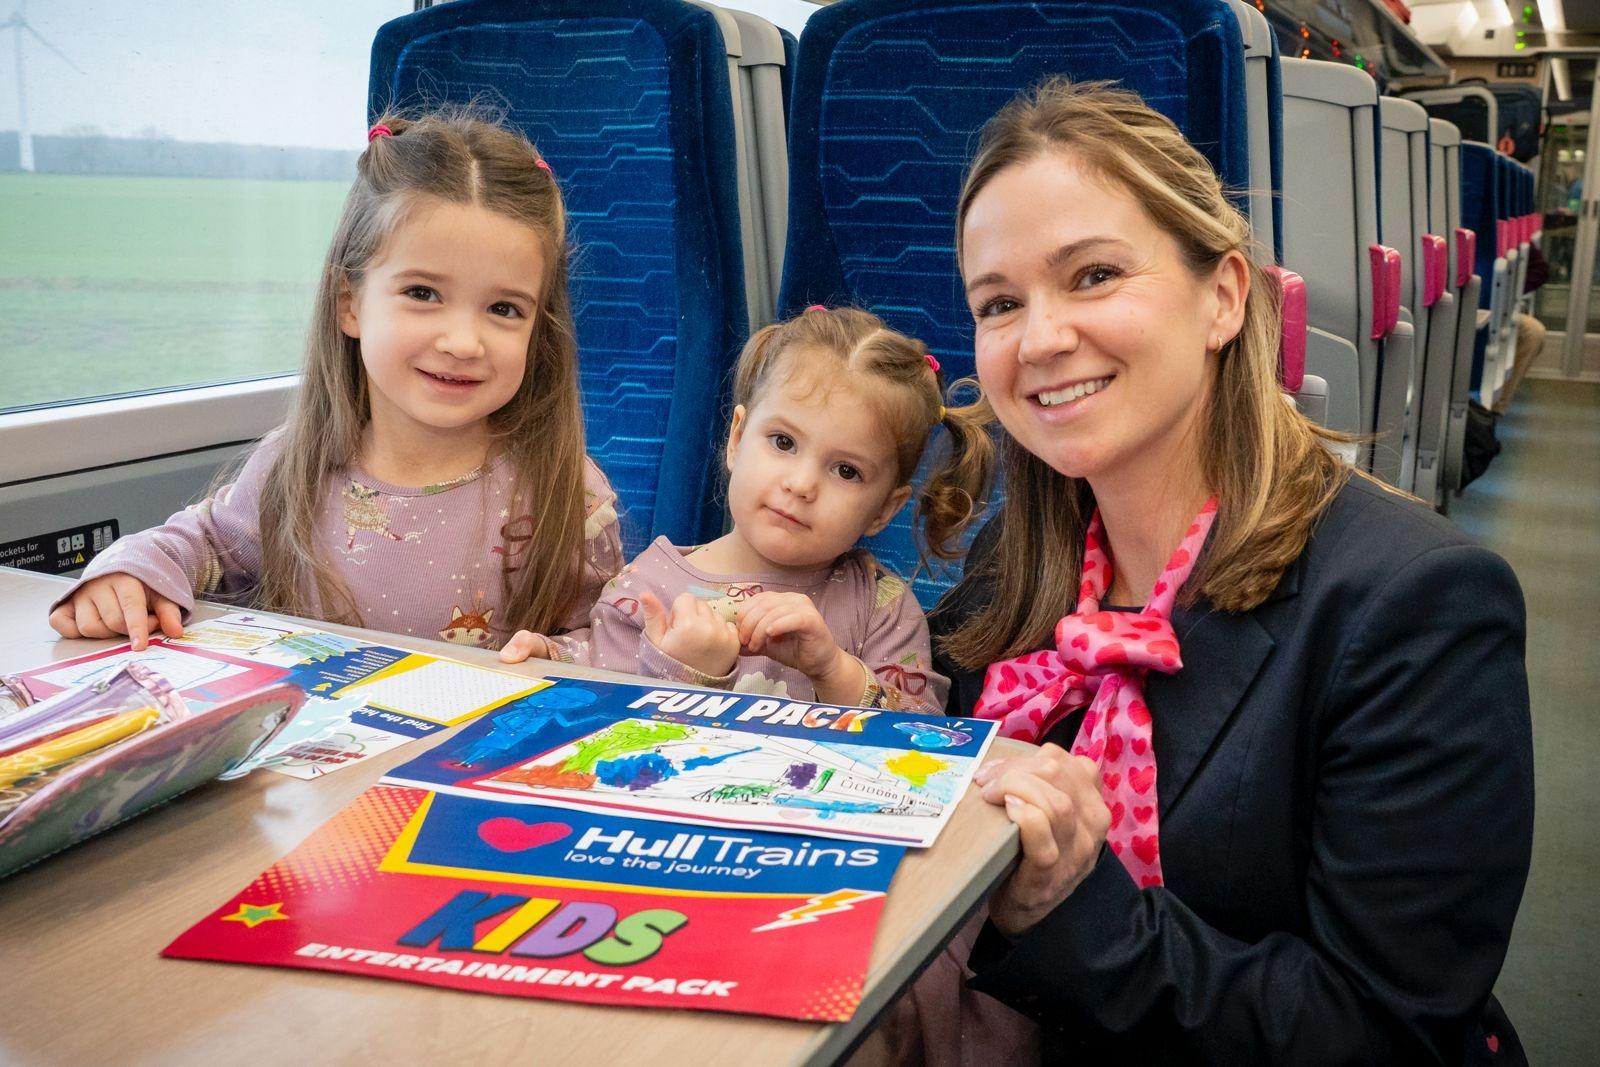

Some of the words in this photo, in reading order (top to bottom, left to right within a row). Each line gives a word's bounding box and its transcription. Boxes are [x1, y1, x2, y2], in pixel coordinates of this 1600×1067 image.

[27, 543, 39, 552] for
[16, 553, 45, 568] phones
[57, 558, 70, 568] 240
[379, 712, 404, 722] the
[626, 690, 742, 718] FUN
[735, 699, 882, 733] PACK
[399, 718, 436, 731] Find
[563, 849, 616, 866] love
[622, 856, 662, 871] the
[663, 860, 762, 879] journey
[397, 890, 689, 967] KIDS
[295, 943, 623, 991] ENTERTAINMENT
[620, 975, 739, 998] PACK
